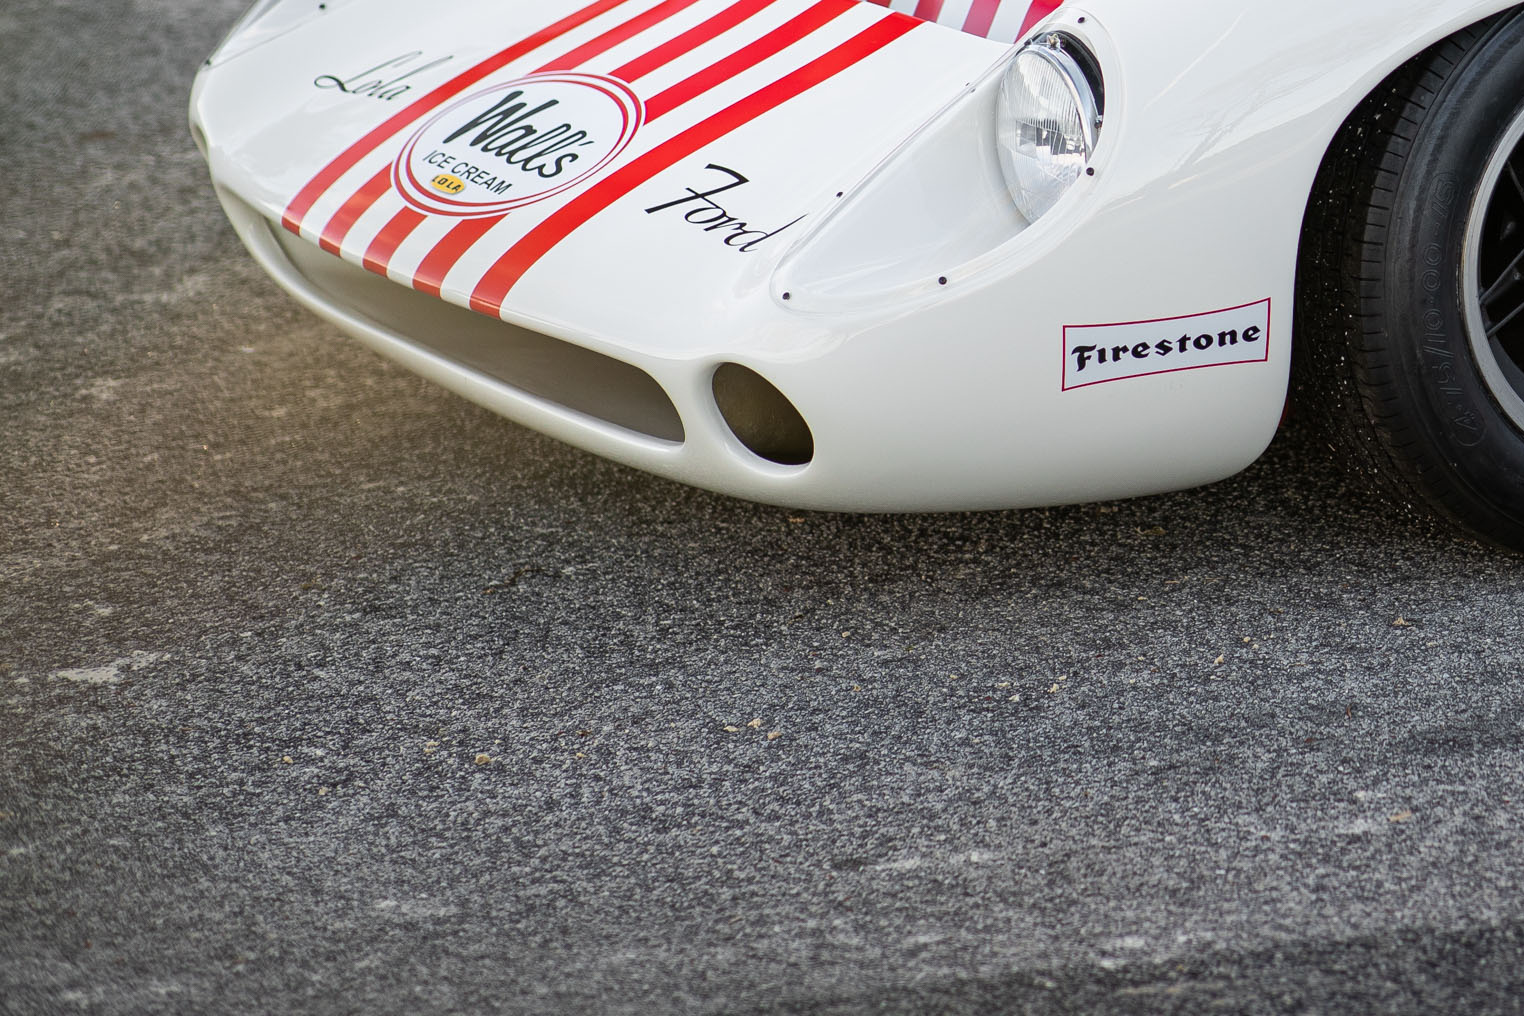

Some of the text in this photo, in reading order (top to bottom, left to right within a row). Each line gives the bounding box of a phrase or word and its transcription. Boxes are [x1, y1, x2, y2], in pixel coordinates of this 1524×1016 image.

[314, 51, 453, 100] Lola
[443, 90, 594, 179] Wall's
[422, 149, 512, 196] ICE CREAM
[431, 174, 461, 193] LOLA
[644, 163, 808, 252] Ford
[1071, 325, 1261, 372] Firestone
